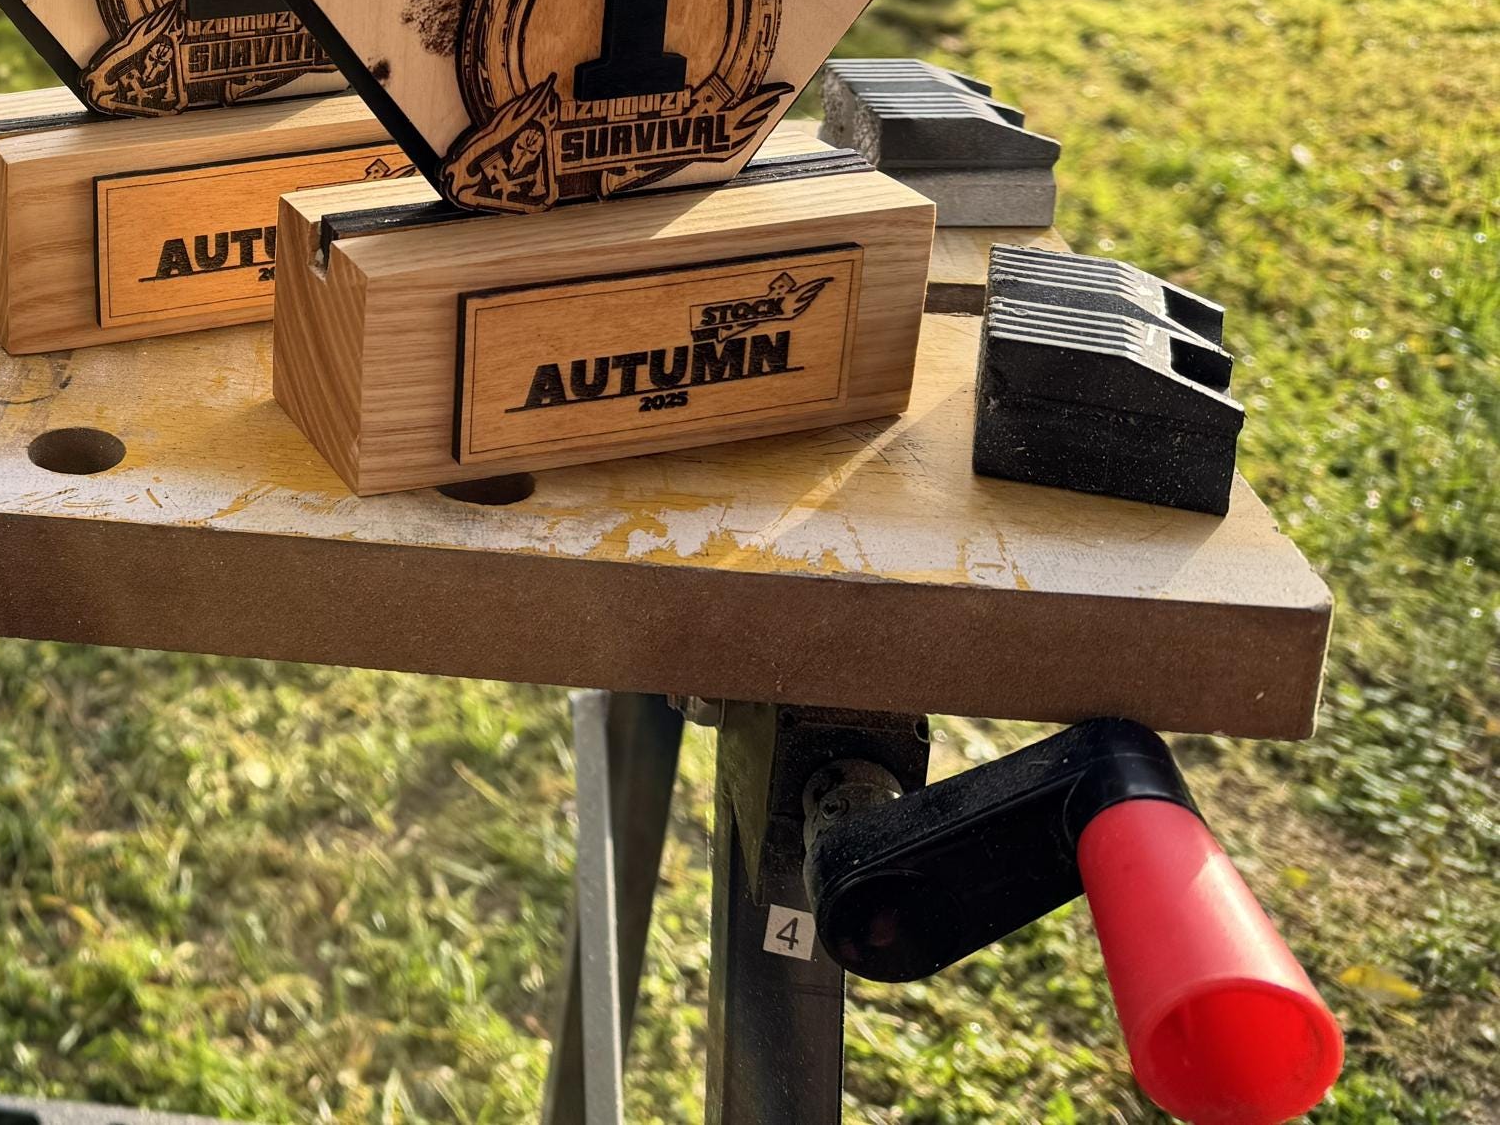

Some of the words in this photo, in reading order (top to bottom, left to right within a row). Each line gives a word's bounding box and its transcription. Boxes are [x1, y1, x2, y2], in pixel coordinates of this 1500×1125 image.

[188, 32, 330, 72] SURVIVA
[561, 114, 730, 163] SURVIVAL
[700, 296, 786, 326] STOCK
[523, 330, 791, 407] AUTUMN
[638, 391, 689, 412] 2025
[776, 917, 799, 950] 4
